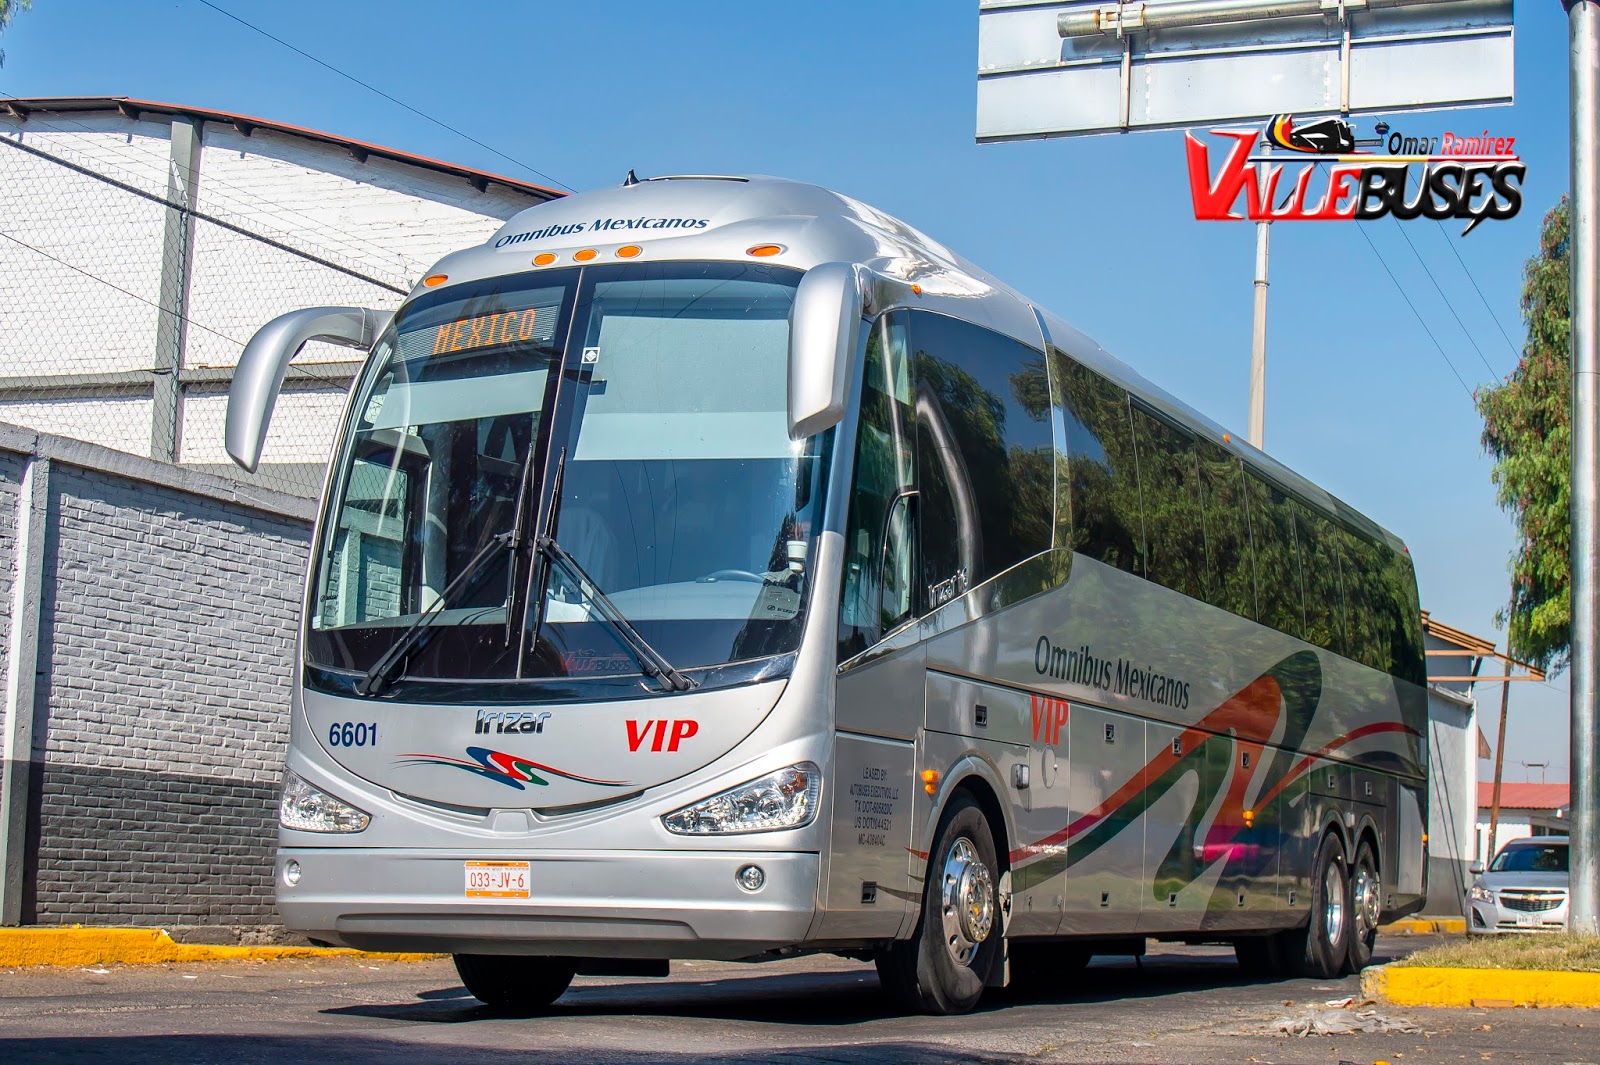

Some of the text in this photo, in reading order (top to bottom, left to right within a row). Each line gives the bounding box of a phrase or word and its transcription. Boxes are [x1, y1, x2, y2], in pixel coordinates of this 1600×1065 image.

[495, 216, 710, 249] Omnibus Mexicanos
[433, 308, 536, 356] MEXICO
[1035, 635, 1190, 710] Omnibus Mexicanos
[328, 722, 378, 747] 6601
[625, 719, 699, 753] VIP
[1031, 694, 1069, 746] VIP
[863, 767, 880, 780] LEASED
[470, 872, 524, 888] 033-JV-6
